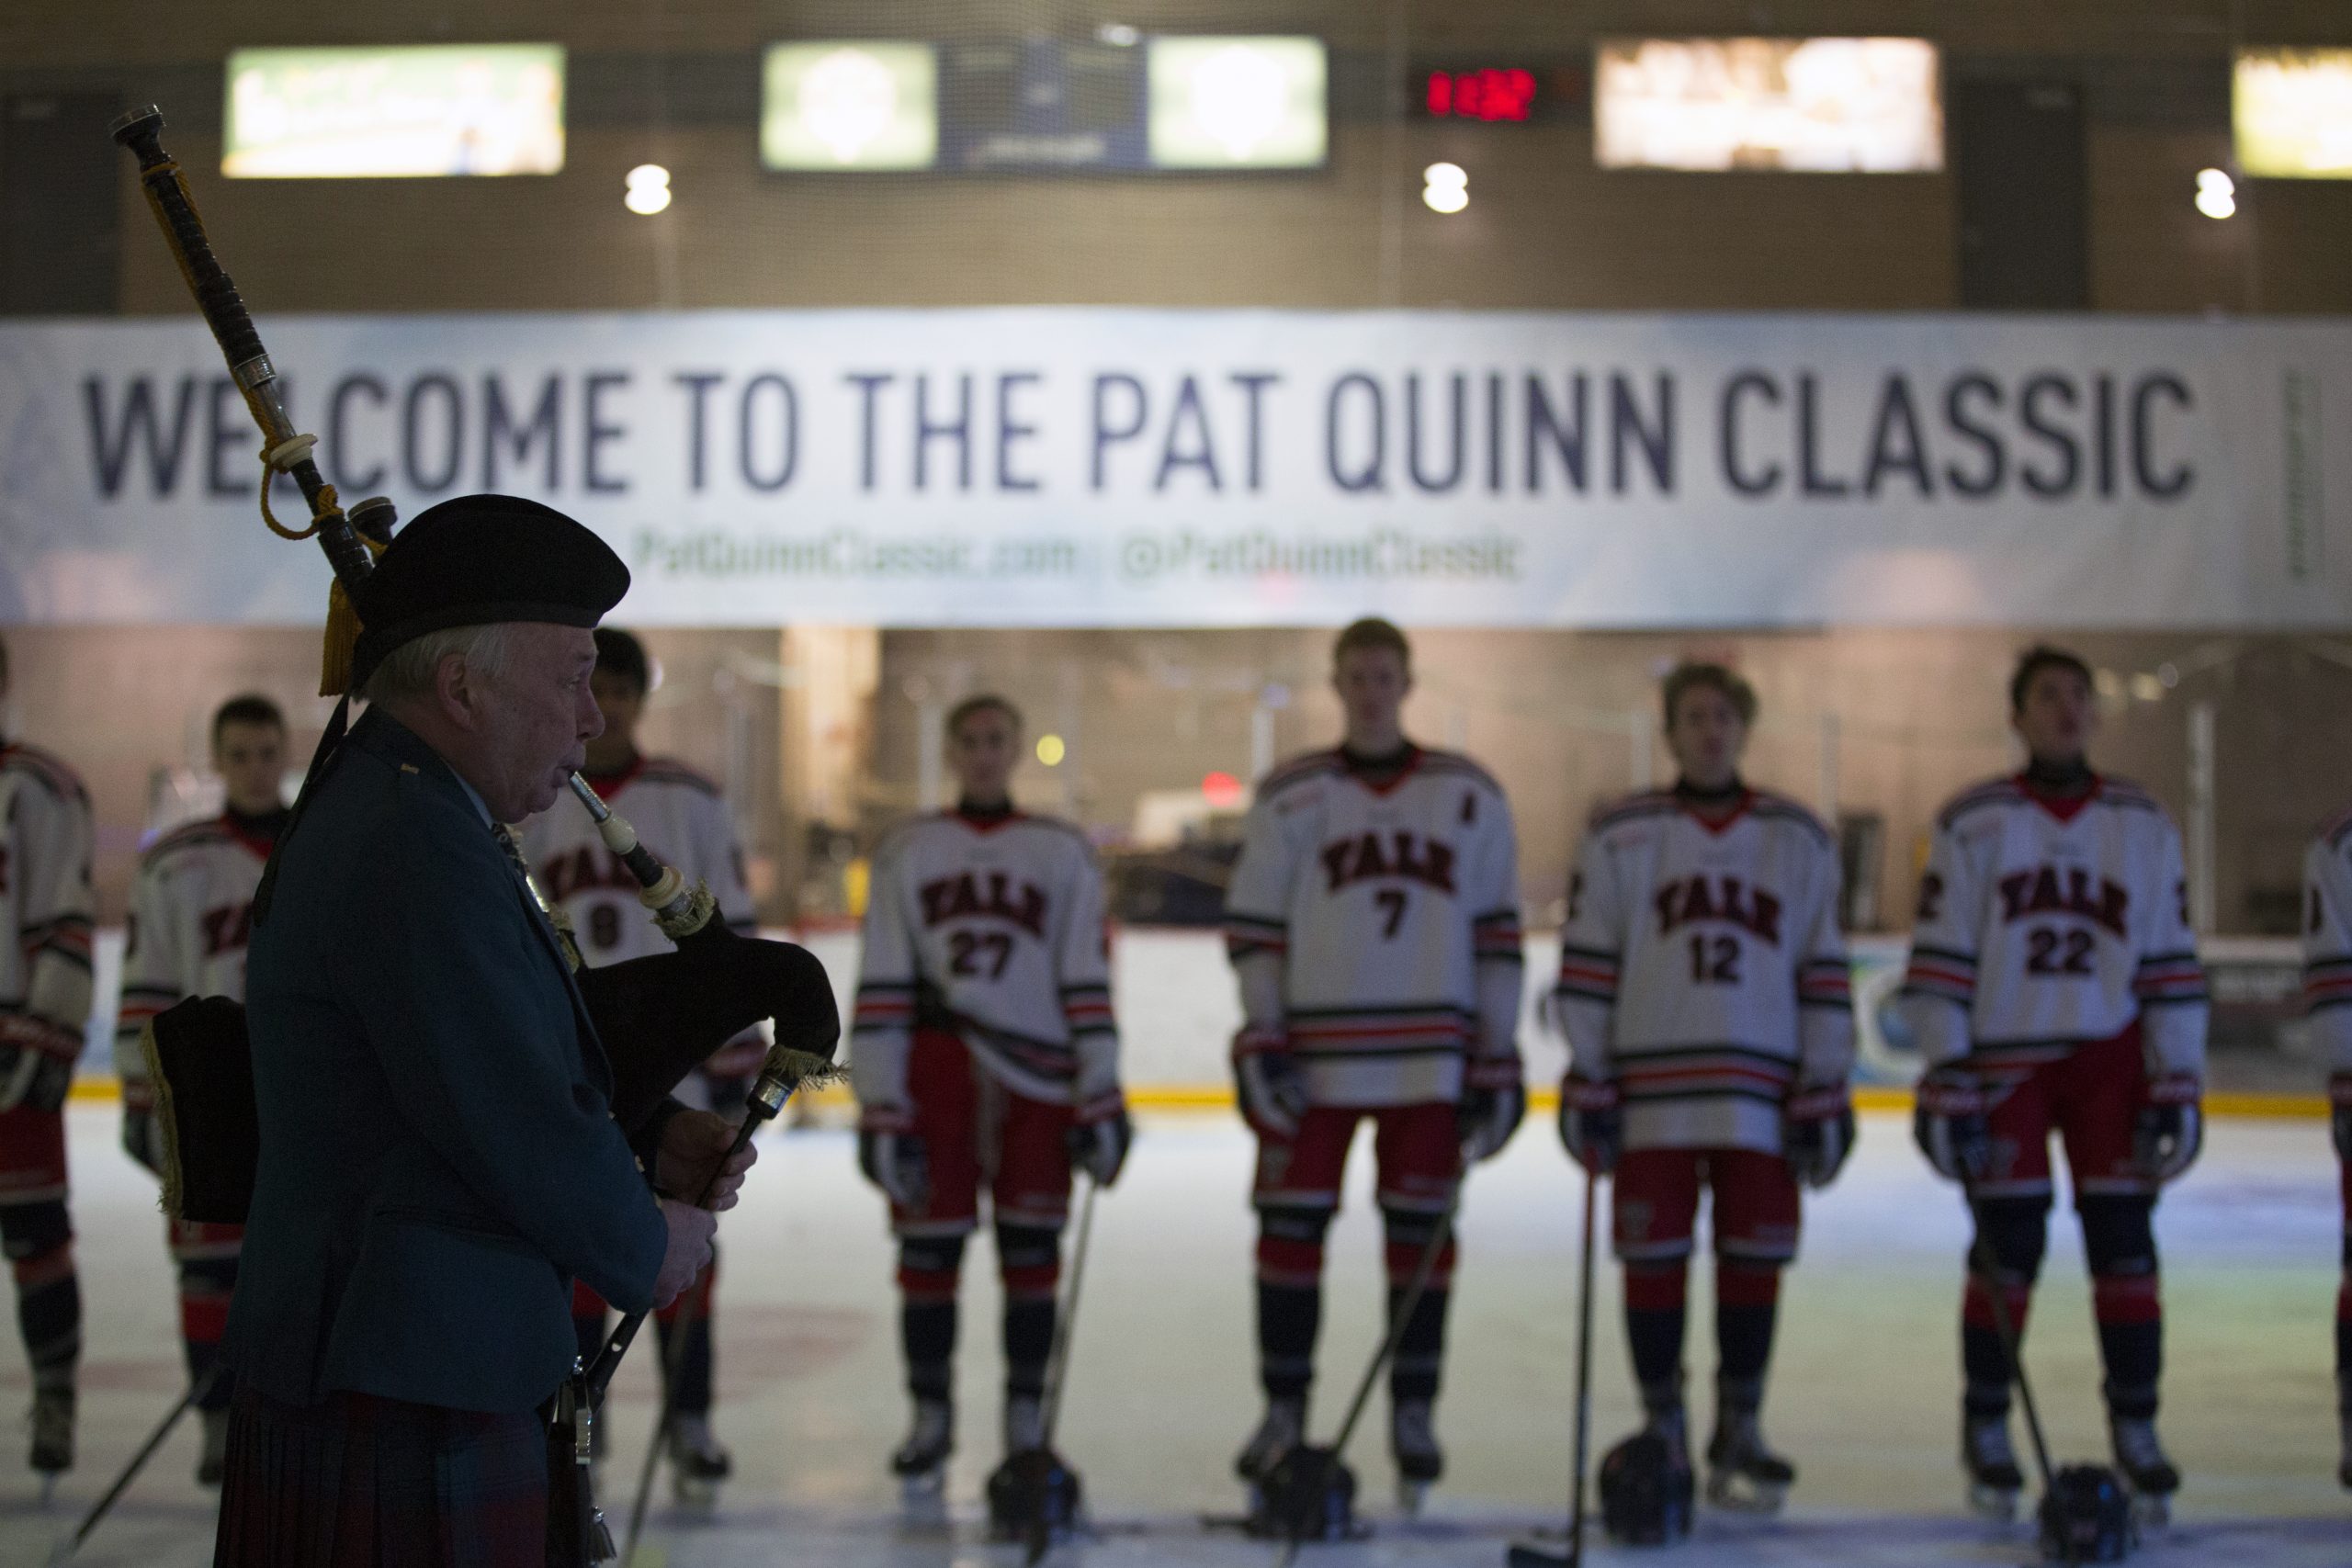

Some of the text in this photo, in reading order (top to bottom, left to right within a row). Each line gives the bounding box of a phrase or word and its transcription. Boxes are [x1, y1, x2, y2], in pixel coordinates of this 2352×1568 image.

[672, 373, 799, 494] TO
[845, 373, 1042, 492] THE
[1091, 373, 1281, 494] PAT
[1327, 373, 1677, 498] QUINN
[1722, 373, 2196, 501] CLASSIC
[1321, 832, 1455, 895] YALE
[920, 871, 1046, 937] YALE
[1376, 892, 1408, 939] 7
[1656, 876, 1781, 946] YALE
[1999, 867, 2127, 939] YALE
[951, 930, 1012, 981] 27
[1690, 935, 1738, 983] 12
[2029, 929, 2094, 974] 22
